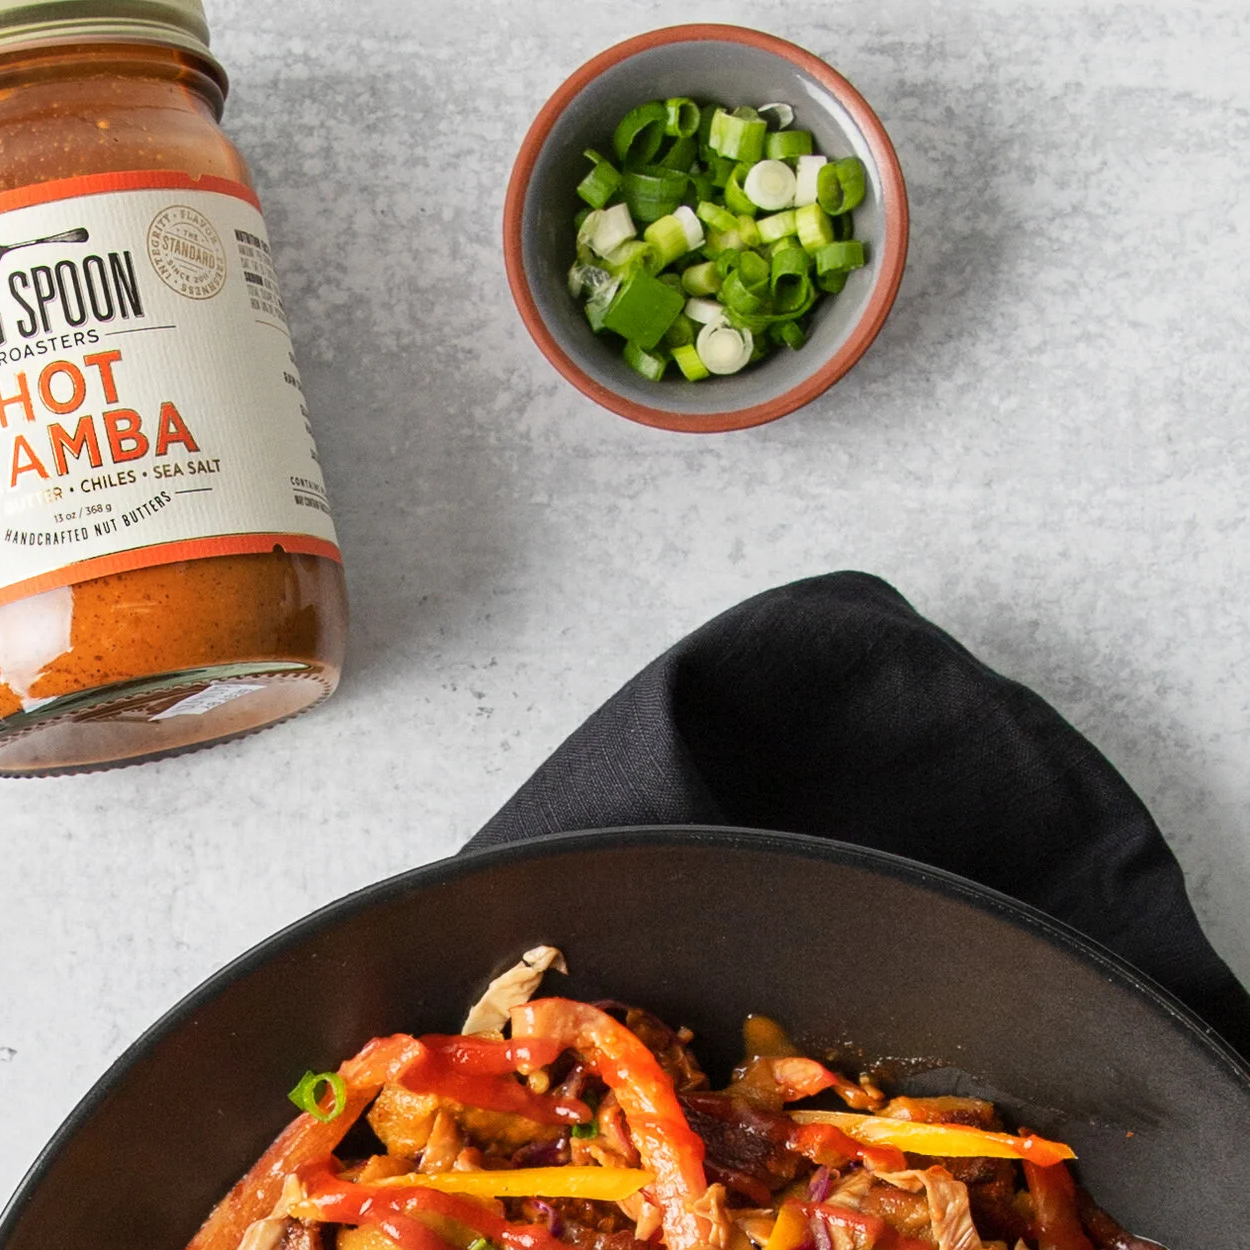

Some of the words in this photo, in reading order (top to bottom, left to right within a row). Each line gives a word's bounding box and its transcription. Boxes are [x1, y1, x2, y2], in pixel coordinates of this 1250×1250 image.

[180, 210, 218, 245] FLAVOR
[184, 230, 199, 241] THE
[151, 213, 171, 280] INTEGRITY
[162, 235, 216, 269] STANDARD
[167, 259, 190, 282] SINCE
[181, 257, 224, 296] FRESHNESS
[8, 250, 145, 339] SPOON
[80, 470, 137, 493] CHILES
[153, 464, 184, 479] SEA
[188, 459, 222, 475] SALT
[4, 527, 89, 548] HANDCRAFTED
[94, 518, 118, 537] NUT
[122, 490, 171, 528] BUTTERS
[54, 512, 65, 524] 13
[66, 511, 77, 520] oz
[86, 502, 104, 517] 368
[105, 504, 113, 515] g
